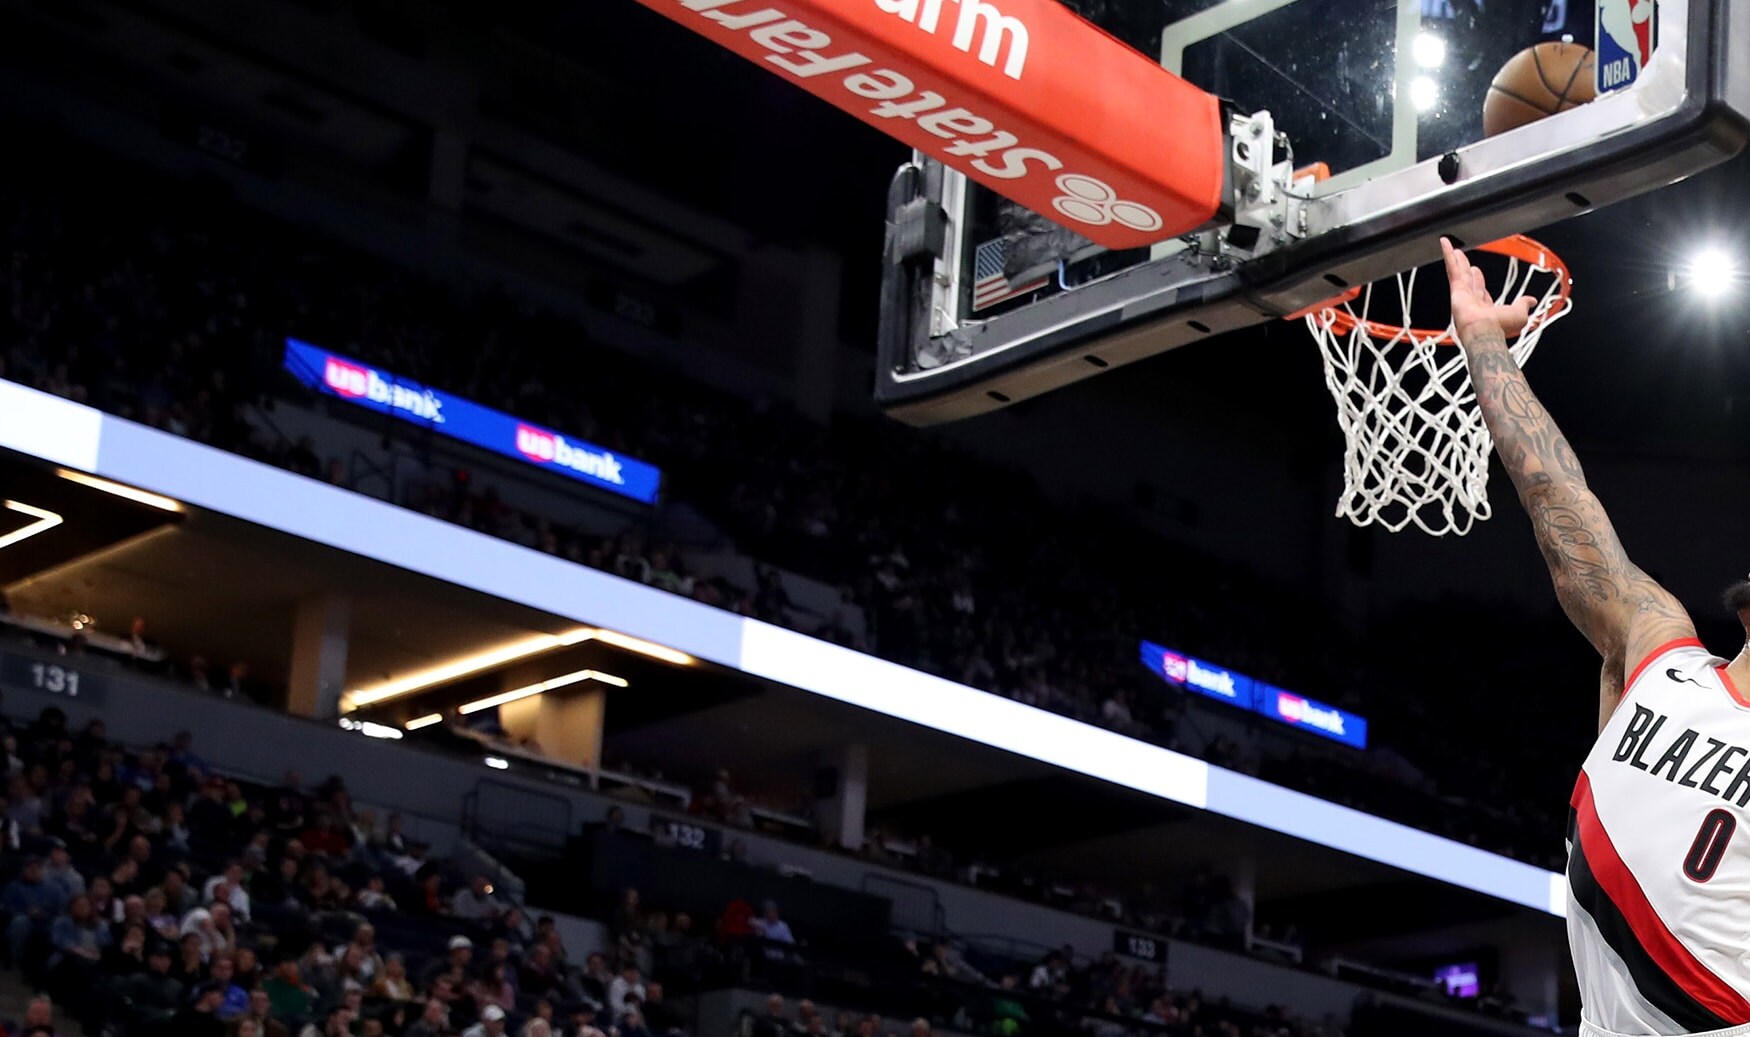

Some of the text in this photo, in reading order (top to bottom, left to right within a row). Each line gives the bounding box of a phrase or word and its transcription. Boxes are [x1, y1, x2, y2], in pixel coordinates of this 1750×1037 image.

[1603, 57, 1631, 89] NBA
[31, 663, 80, 697] 131
[668, 823, 706, 850] 132
[1683, 808, 1738, 884] 0
